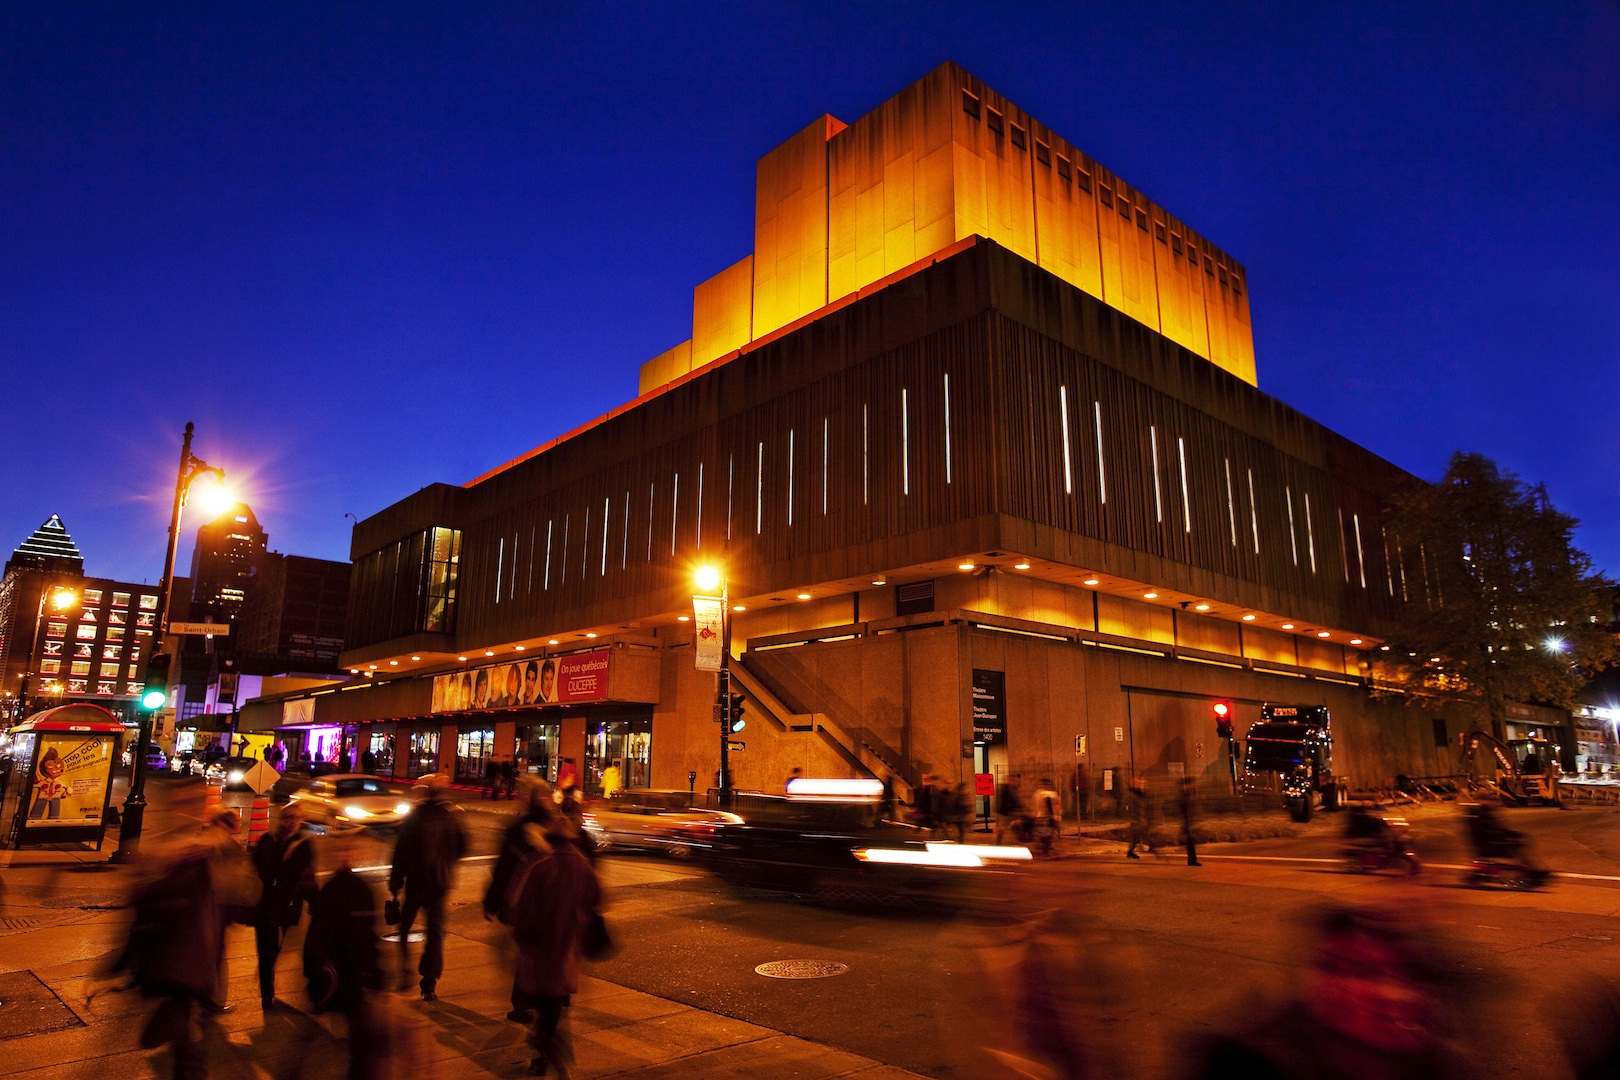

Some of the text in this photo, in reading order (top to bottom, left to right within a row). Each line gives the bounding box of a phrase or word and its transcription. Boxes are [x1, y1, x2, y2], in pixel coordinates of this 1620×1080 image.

[561, 659, 608, 675] On joue québécois
[568, 678, 598, 691] DUCEPPE
[64, 738, 102, 764] trop cool
[67, 759, 82, 768] pour
